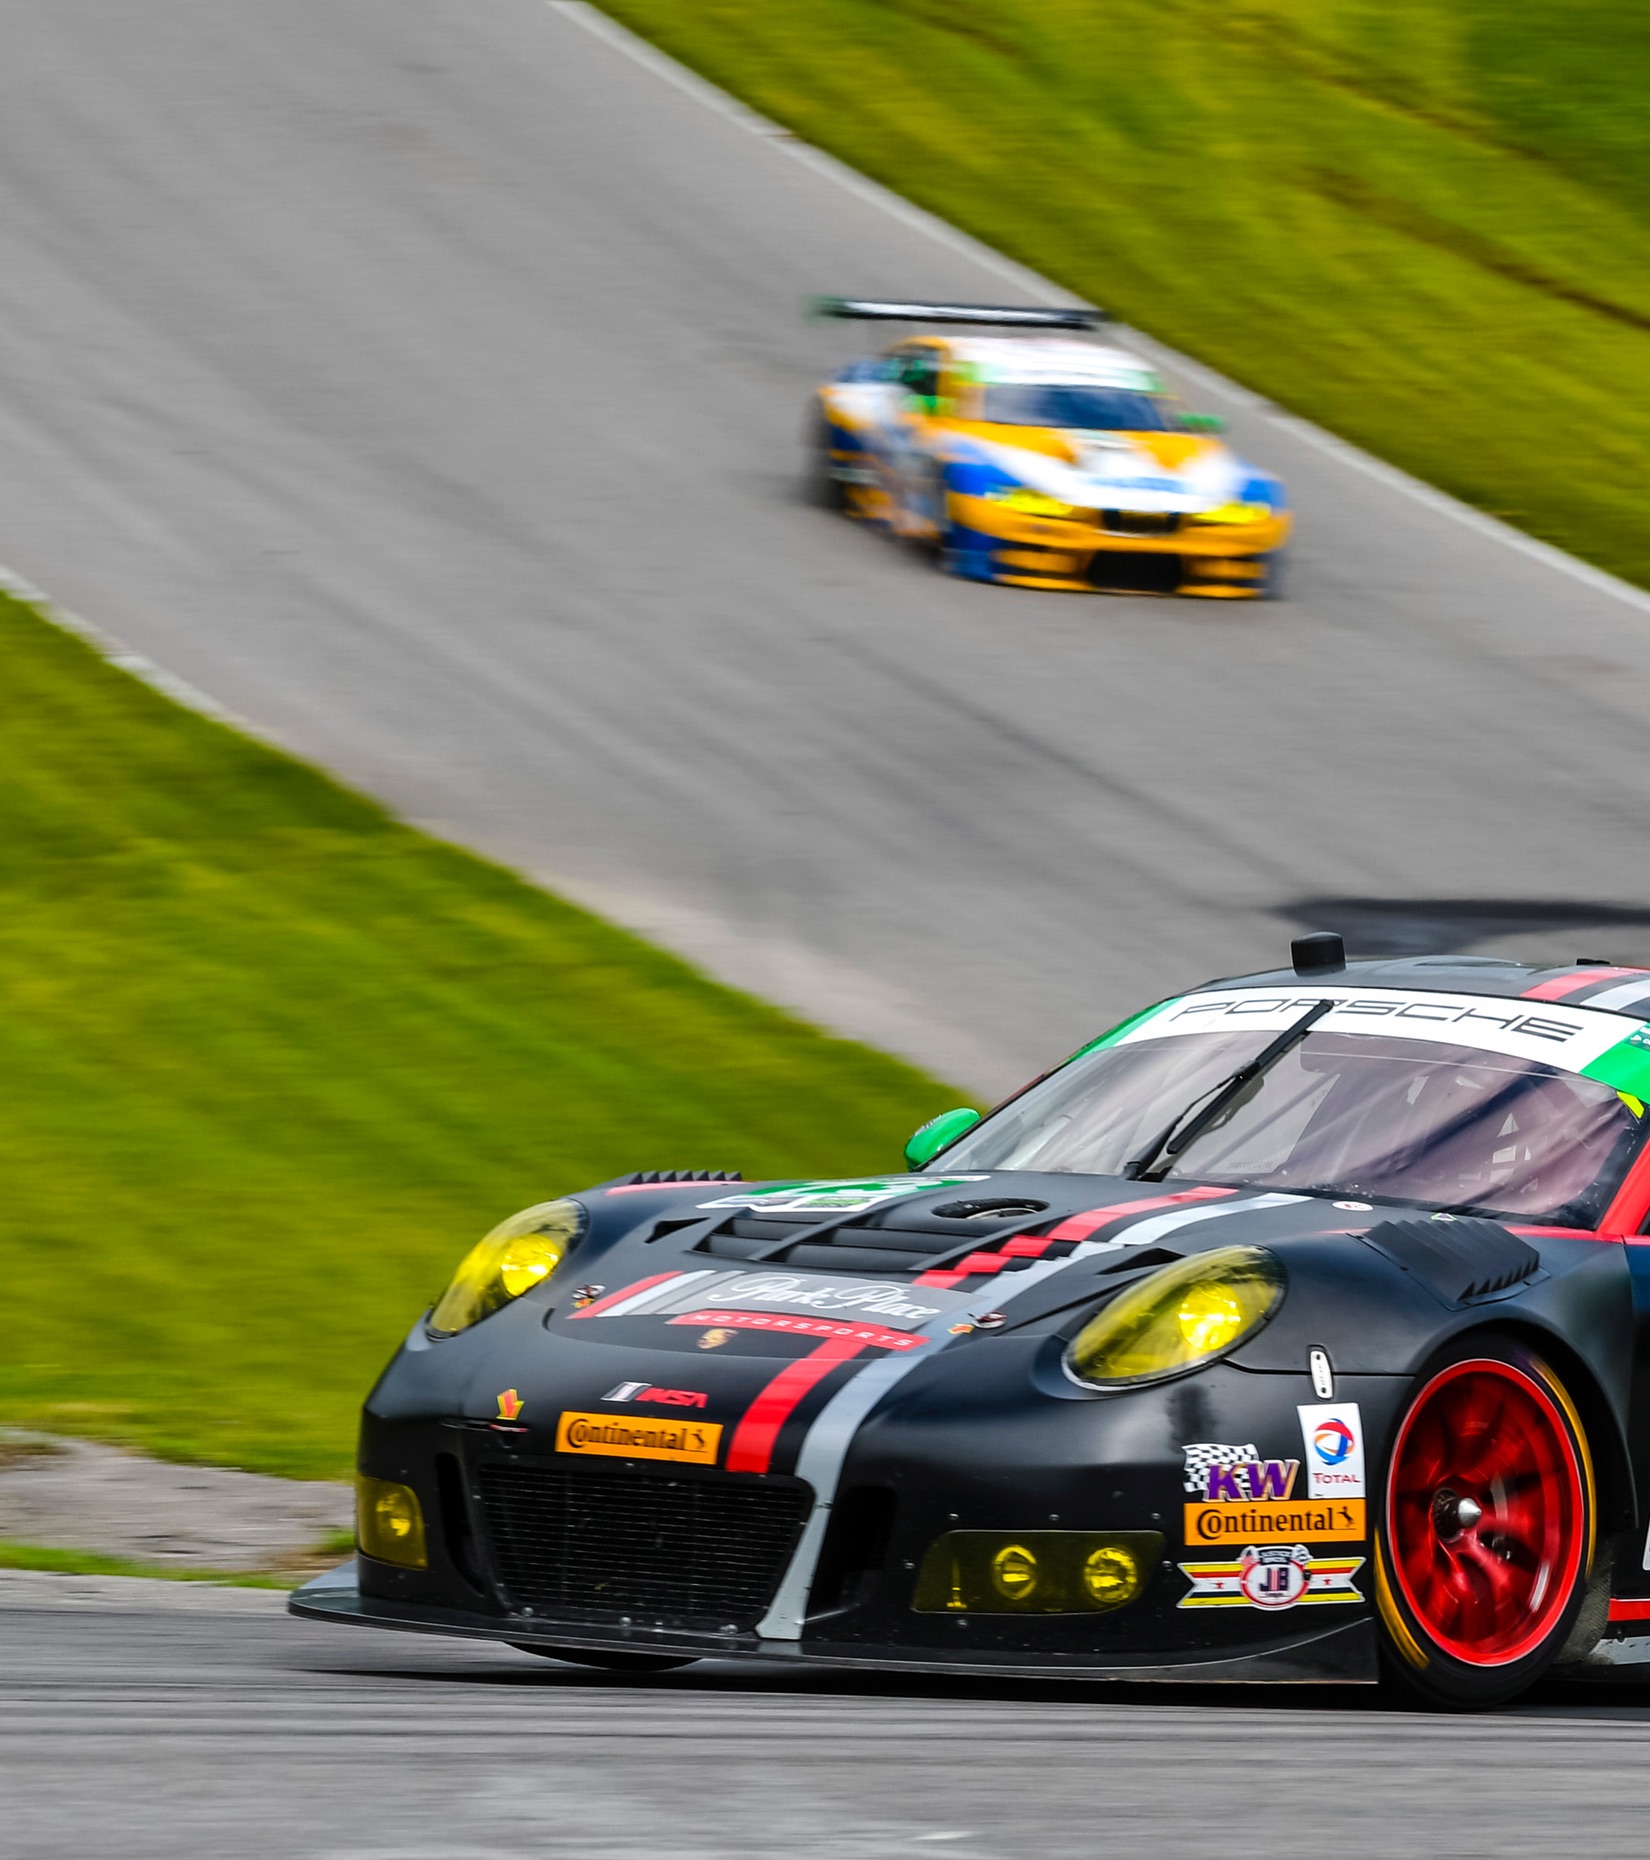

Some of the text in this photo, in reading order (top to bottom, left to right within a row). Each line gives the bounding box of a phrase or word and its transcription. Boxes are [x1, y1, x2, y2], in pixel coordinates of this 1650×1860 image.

[693, 1314, 914, 1347] MOTORSPORTS
[567, 1418, 687, 1451] Continental
[1203, 1459, 1300, 1503] KW
[1312, 1473, 1361, 1483] TOTAL
[1197, 1507, 1334, 1541] Continental
